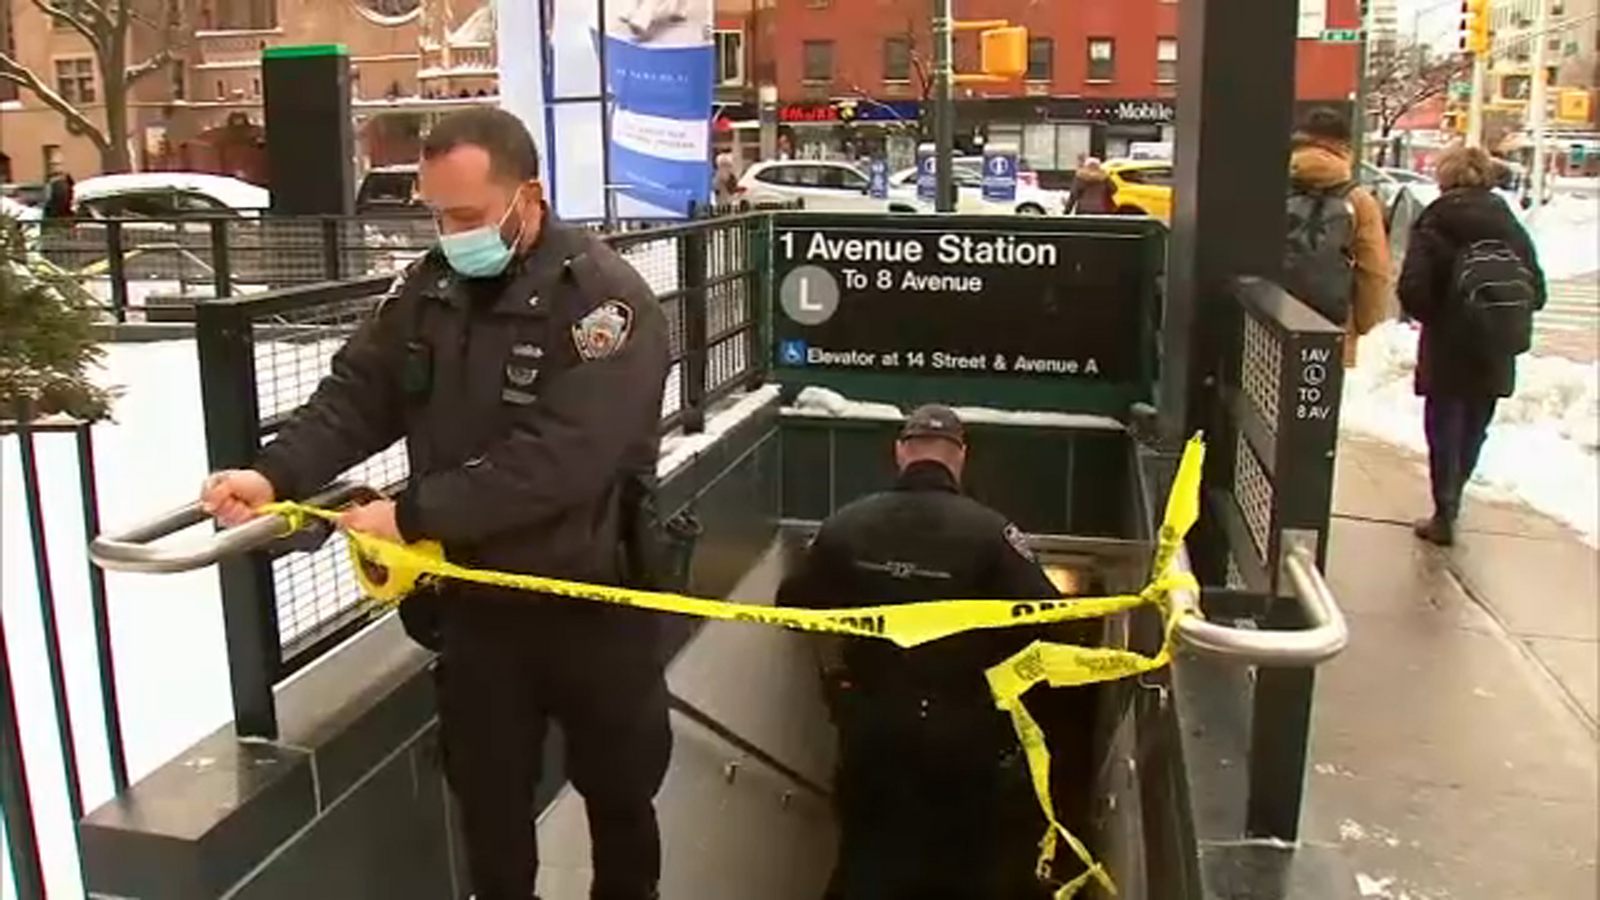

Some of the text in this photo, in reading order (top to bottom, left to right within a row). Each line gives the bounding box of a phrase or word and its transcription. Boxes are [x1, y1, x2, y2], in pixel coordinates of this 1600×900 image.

[780, 232, 1057, 266] 1 Avenue Station
[842, 269, 983, 293] To 8 Avenue
[798, 278, 823, 311] L
[807, 347, 1098, 374] Elevator at 14 Street & Avenue A
[1298, 388, 1321, 402] TO
[1296, 405, 1331, 419] 8 AV
